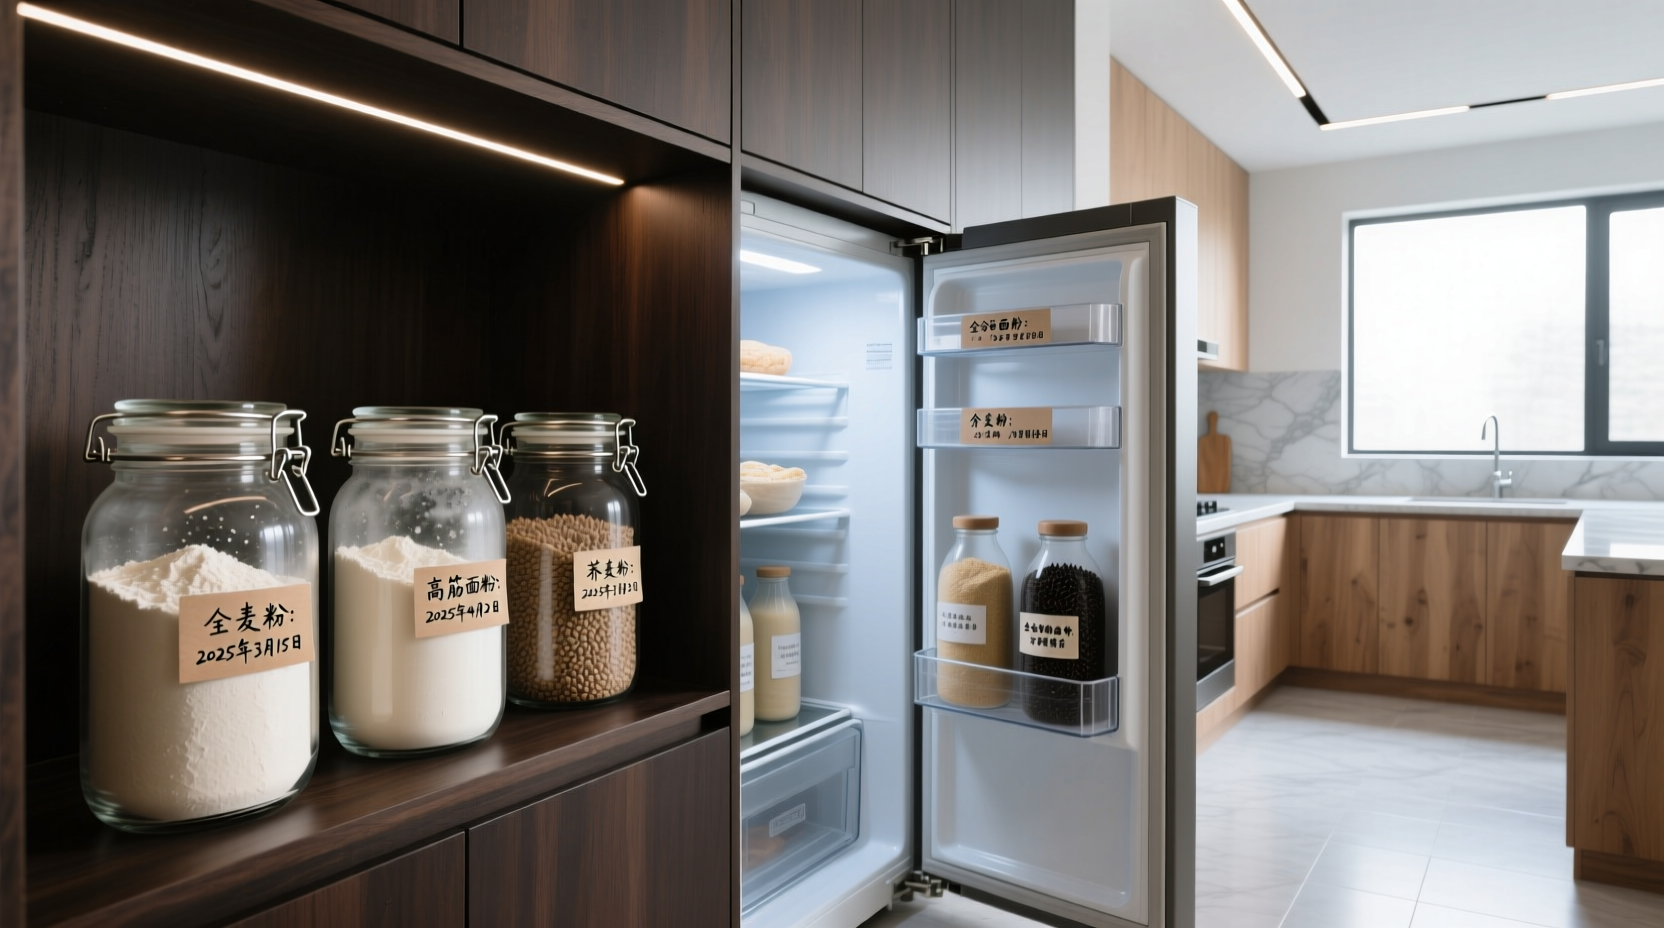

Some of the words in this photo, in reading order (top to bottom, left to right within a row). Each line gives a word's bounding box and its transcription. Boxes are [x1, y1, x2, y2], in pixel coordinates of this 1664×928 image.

[427, 574, 500, 601] 高筋面粉:
[203, 601, 294, 636] 全麦粉:
[426, 600, 499, 624] 2025年4月2日
[196, 634, 301, 665] 2025年3月15日
